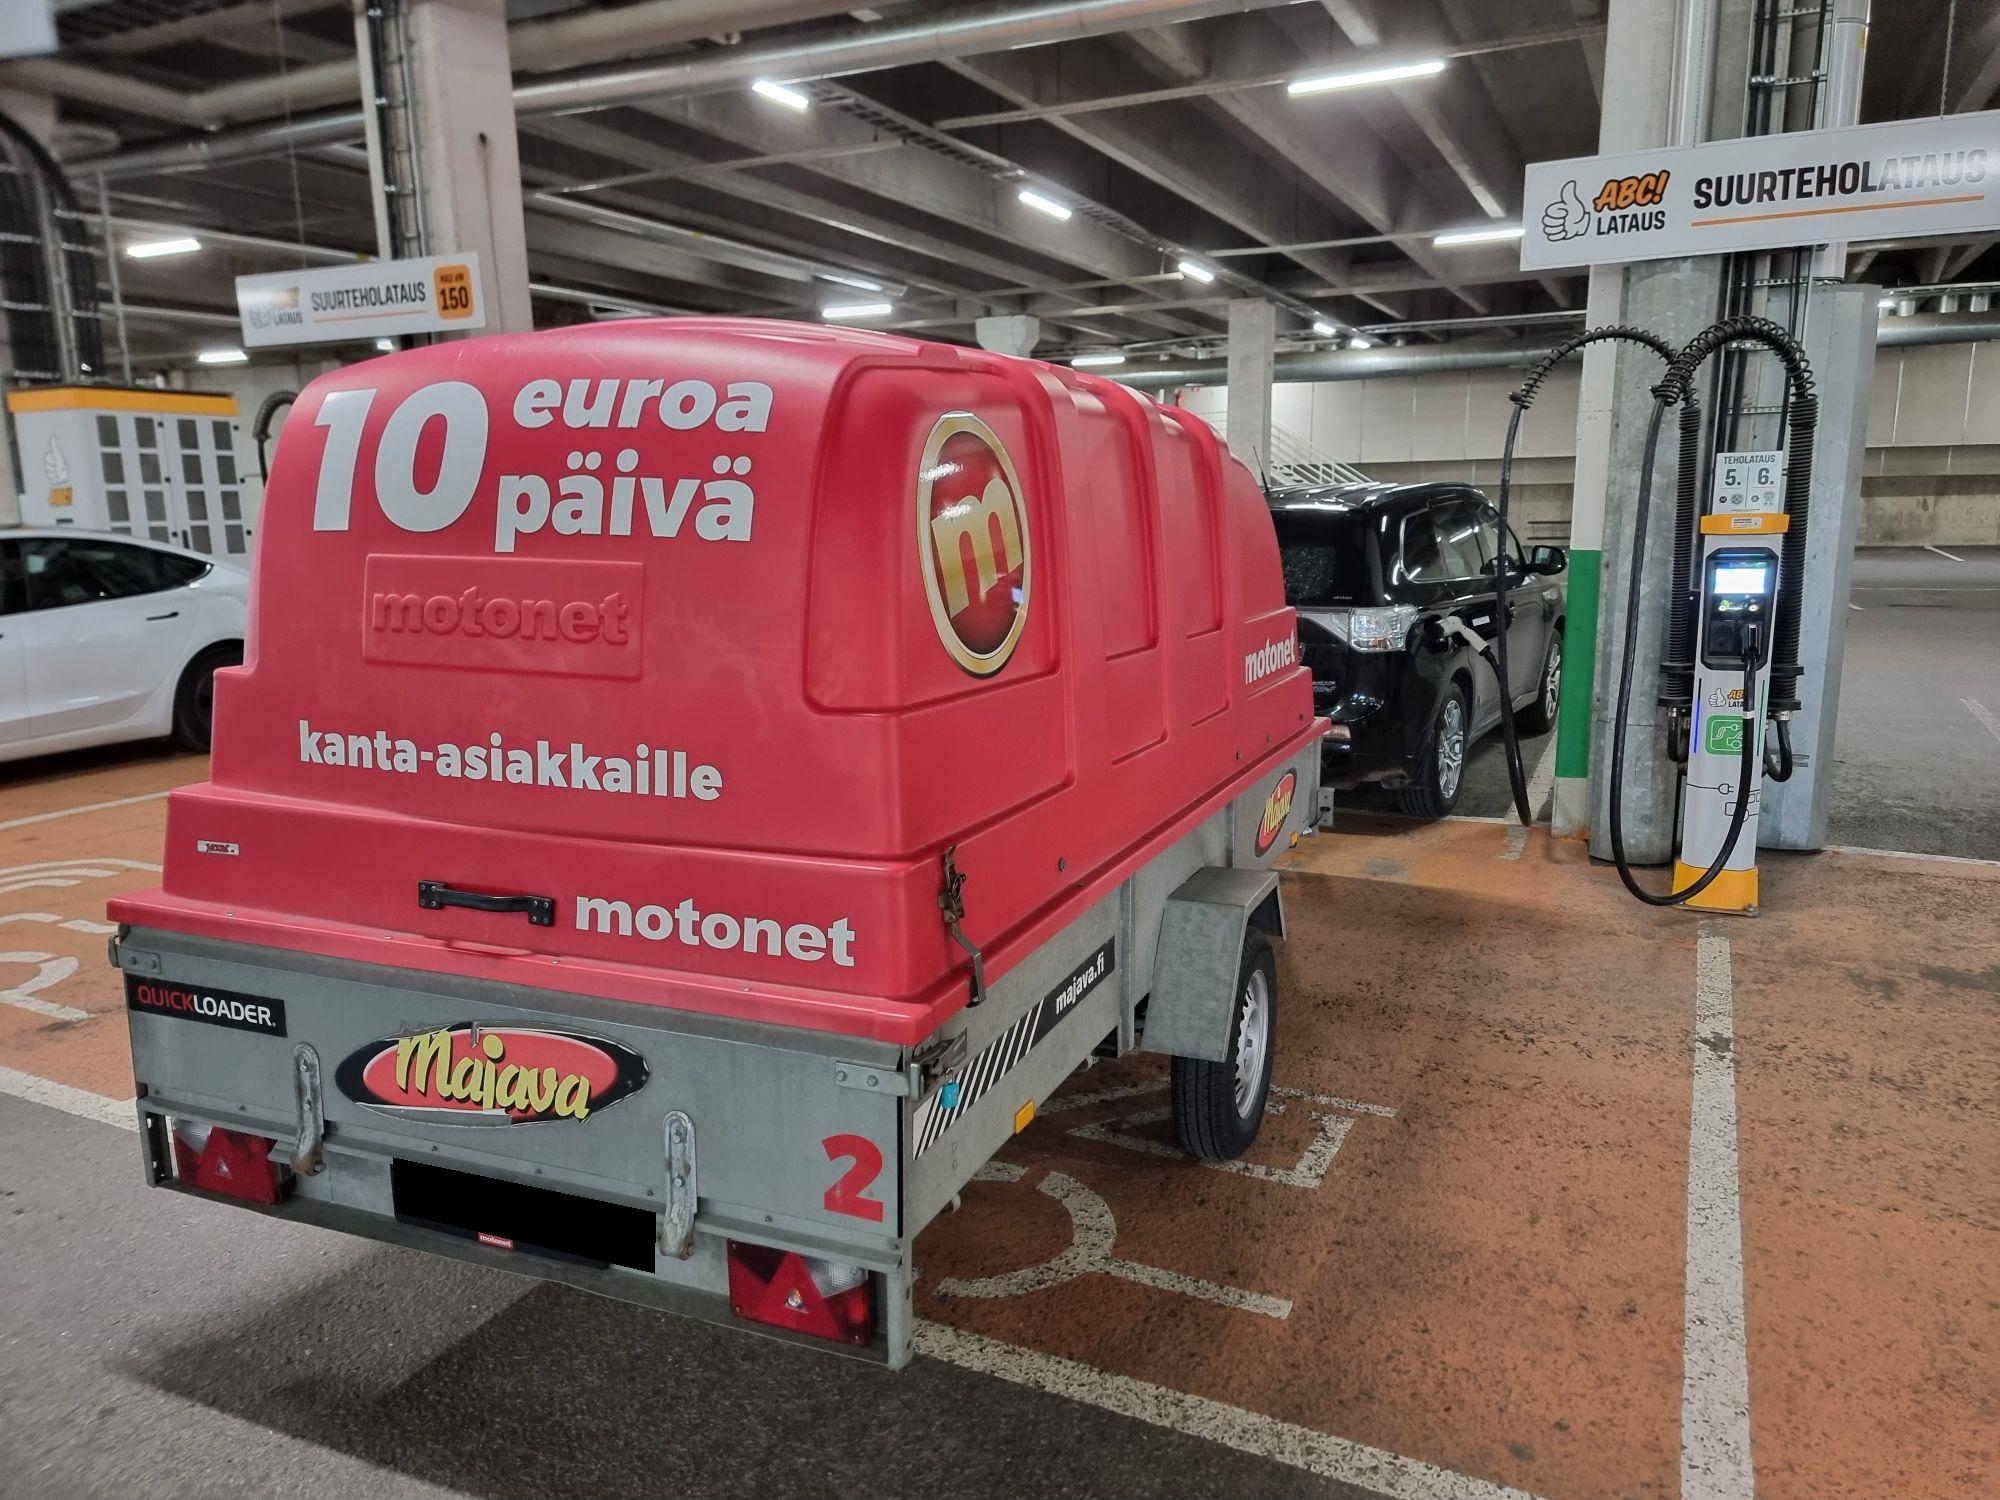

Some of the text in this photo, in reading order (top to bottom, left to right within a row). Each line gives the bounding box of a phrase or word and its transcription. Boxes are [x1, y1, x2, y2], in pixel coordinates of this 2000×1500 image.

[1594, 169, 1671, 213] ABC!
[1693, 148, 1987, 208] SUURTEHOLATAUS
[1596, 210, 1666, 236] LATAUS
[310, 281, 427, 312] SUURTEHOLATAUS
[440, 286, 469, 310] 150
[513, 379, 774, 433] euroa
[312, 380, 489, 533] 10
[1723, 454, 1776, 465] TEHOLATAUS
[1724, 468, 1742, 487] 5.
[1757, 467, 1775, 486] 6.
[494, 448, 756, 553] päivä
[371, 586, 630, 645] motonet
[1244, 629, 1296, 685] motonet
[299, 719, 724, 802] kanta-asiakkaille
[575, 895, 856, 968] motonet
[1055, 949, 1105, 1015] majava.fi
[395, 1029, 592, 1120] Majava
[821, 1133, 884, 1223] 2
